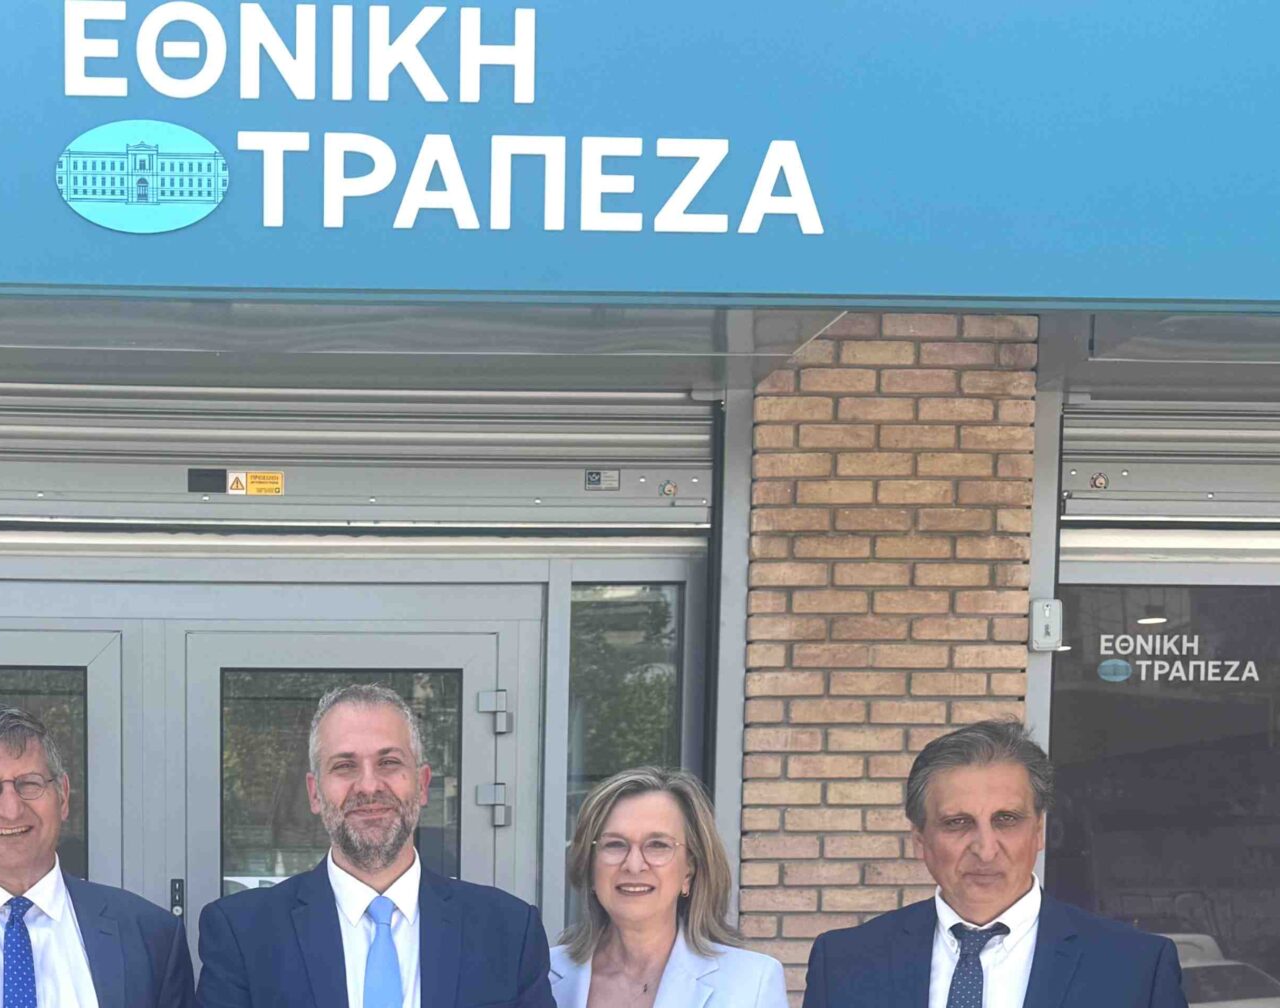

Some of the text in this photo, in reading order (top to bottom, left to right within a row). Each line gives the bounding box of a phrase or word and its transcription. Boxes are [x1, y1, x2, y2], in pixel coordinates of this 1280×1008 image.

[64, 0, 536, 104] ΕΘΝΙΚΗ
[237, 130, 825, 236] ΤΡΑΠΕΖΑ
[1100, 634, 1199, 655] ΕΘΝΙΚΗ
[1136, 661, 1260, 681] ΤΡΑΠΕΖΑ
